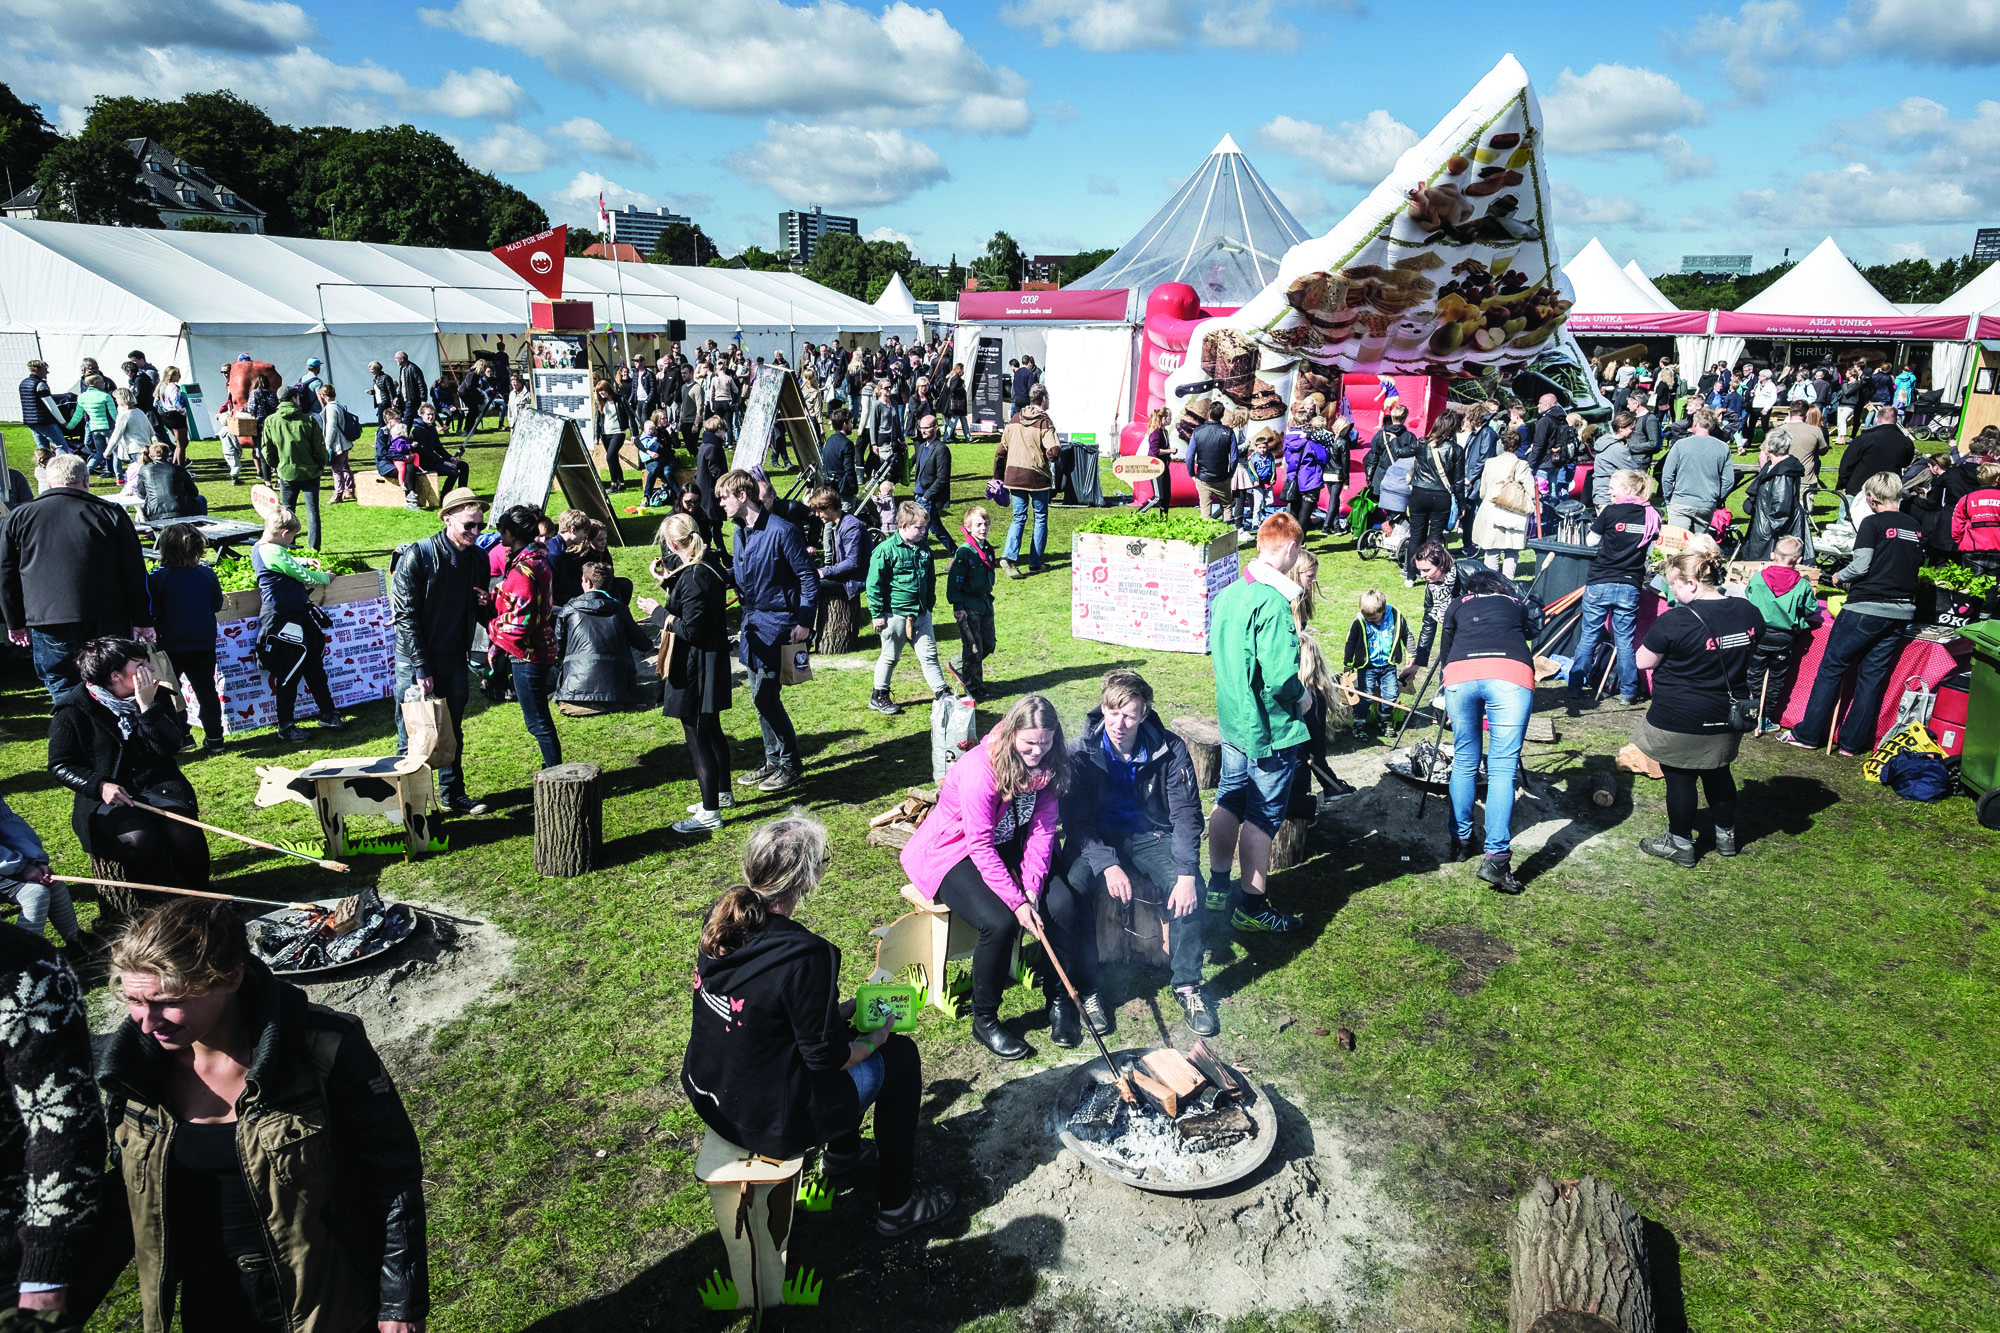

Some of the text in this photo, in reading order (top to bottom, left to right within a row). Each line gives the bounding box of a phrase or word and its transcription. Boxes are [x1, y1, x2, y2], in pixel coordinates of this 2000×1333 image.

[505, 229, 554, 252] MAD FOR BØRN
[1020, 295, 1039, 304] COOP
[1808, 318, 1873, 327] ARLA UNIKA
[1794, 346, 1835, 356] SIRIUS
